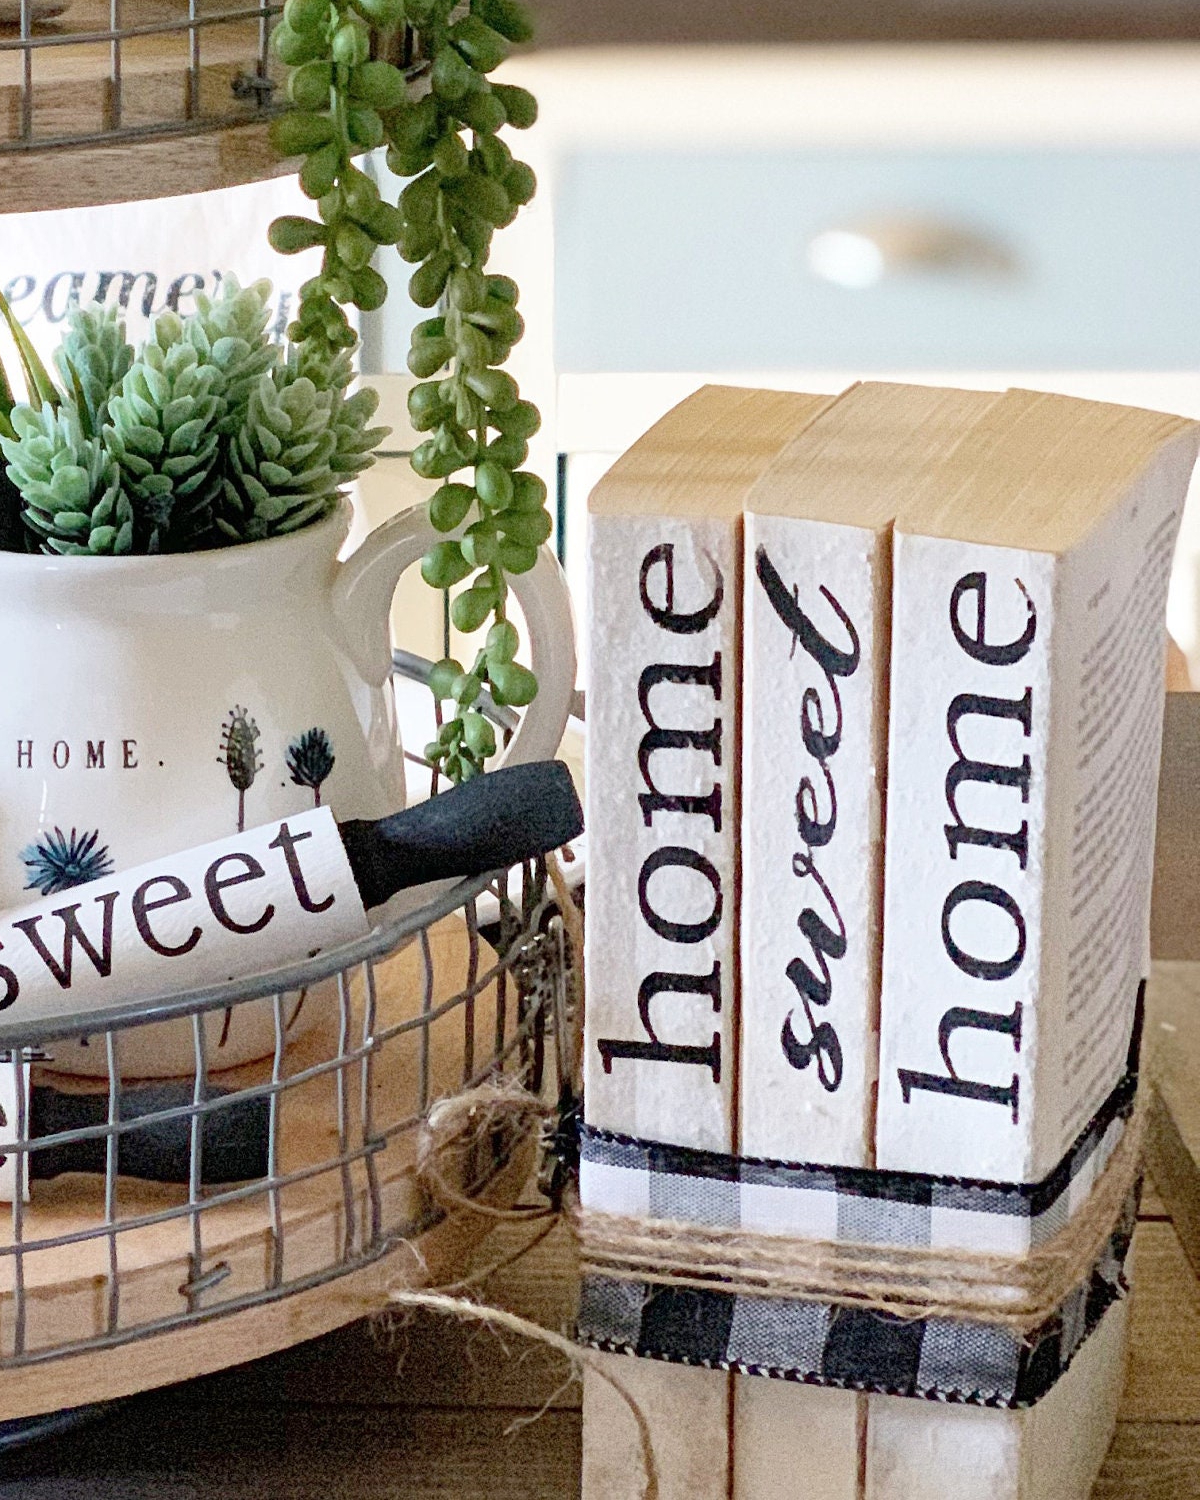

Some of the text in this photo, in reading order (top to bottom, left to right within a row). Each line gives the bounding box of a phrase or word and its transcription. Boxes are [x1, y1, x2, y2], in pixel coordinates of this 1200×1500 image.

[16, 739, 164, 769] HOME.
[597, 542, 724, 1083] home
[754, 543, 860, 1092] sweet
[898, 570, 1037, 1125] home
